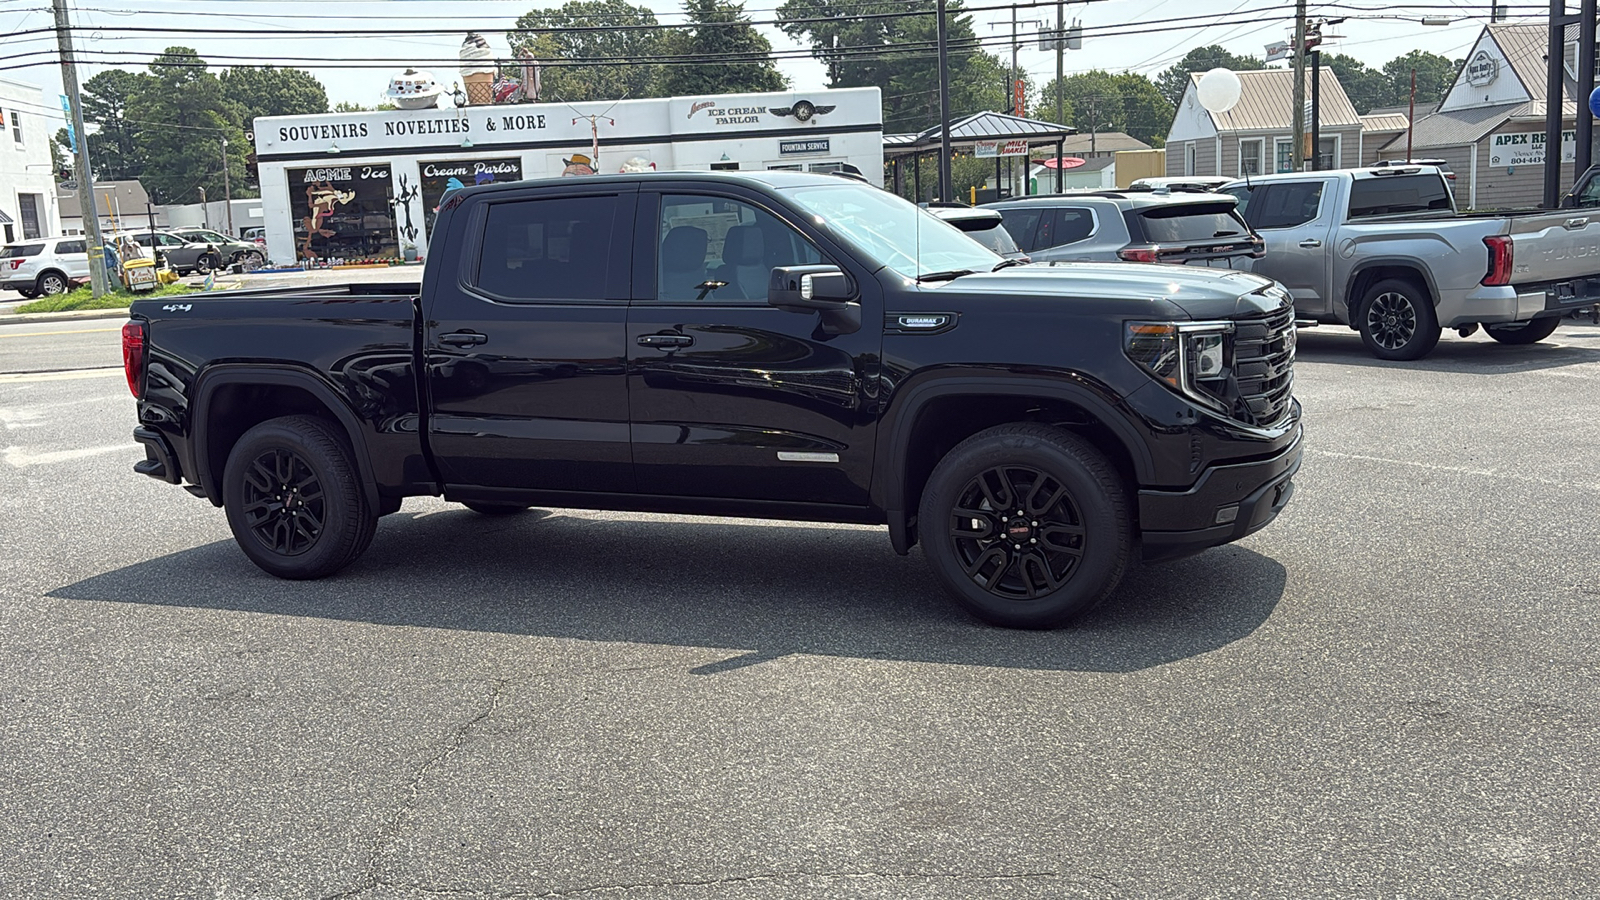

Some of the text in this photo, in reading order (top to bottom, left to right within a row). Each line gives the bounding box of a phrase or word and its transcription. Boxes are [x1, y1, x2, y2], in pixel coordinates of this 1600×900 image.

[708, 106, 767, 117] ICE CREAM
[715, 116, 760, 126] PARLOR
[279, 114, 547, 142] SOUVENIRS NOVELTIES & MORE
[1006, 140, 1028, 148] MILK
[1495, 131, 1577, 146] APEX RETY
[781, 141, 828, 152] FOUNTAIN SERVICE
[1510, 157, 1547, 165] 804-443-
[304, 166, 389, 183] ACME Ice
[423, 162, 519, 178] Cream Parlor
[1212, 245, 1234, 253] GMC
[1541, 245, 1600, 262] TUNDR
